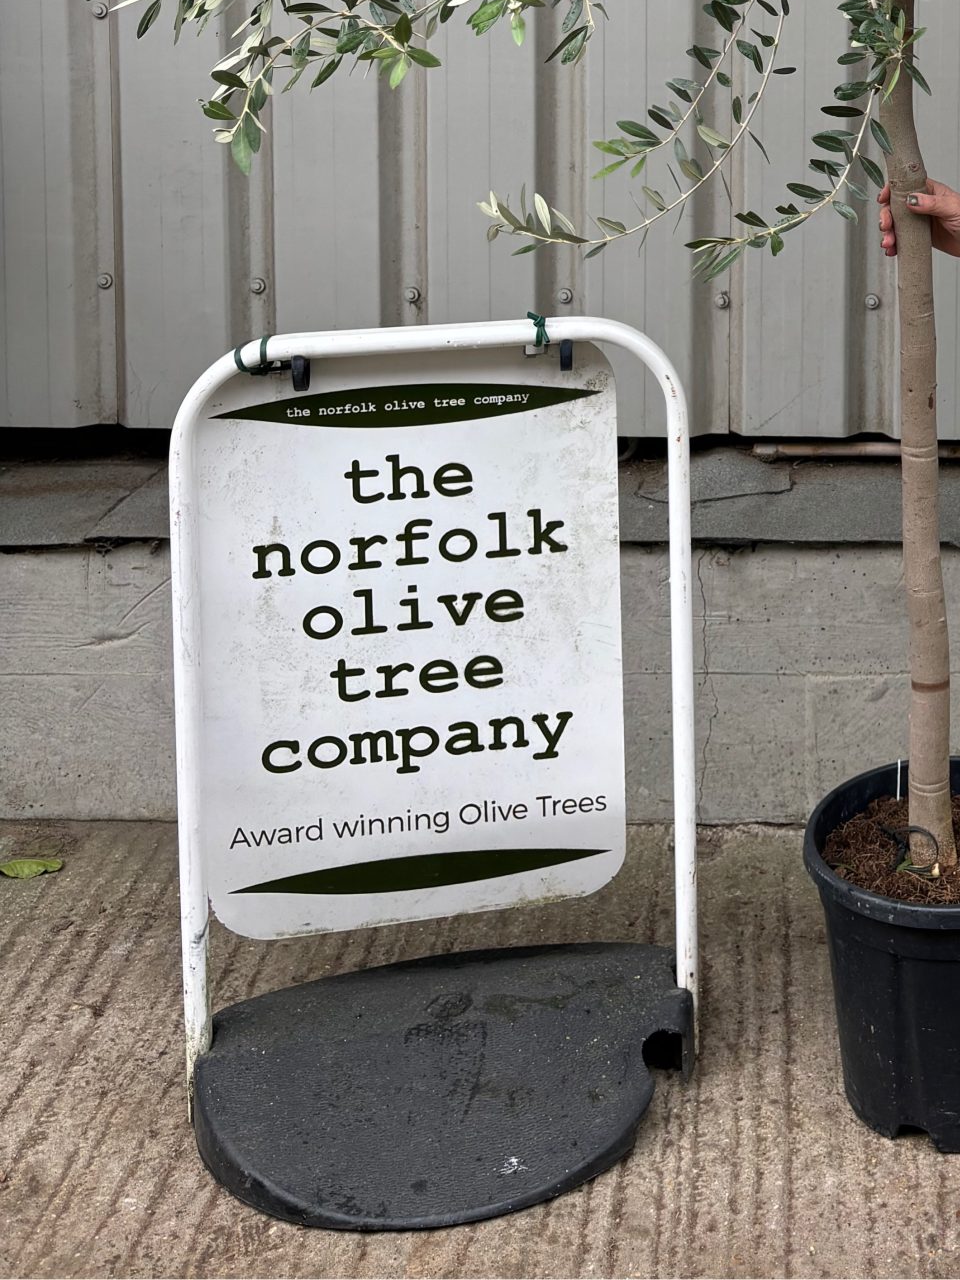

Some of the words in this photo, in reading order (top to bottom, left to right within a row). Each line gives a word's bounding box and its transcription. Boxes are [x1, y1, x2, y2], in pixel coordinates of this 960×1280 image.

[286, 406, 311, 418] the
[318, 402, 377, 416] norfolk
[384, 400, 425, 411] olive
[432, 397, 466, 408] tree
[473, 393, 530, 406] company
[343, 454, 473, 504] the
[252, 508, 569, 580] norfolk
[302, 584, 525, 640] olive
[329, 655, 504, 703] tree
[261, 711, 574, 775] company
[229, 818, 325, 850] Award
[332, 808, 450, 839] winning
[458, 798, 529, 826] Olive
[535, 794, 607, 818] Trees
